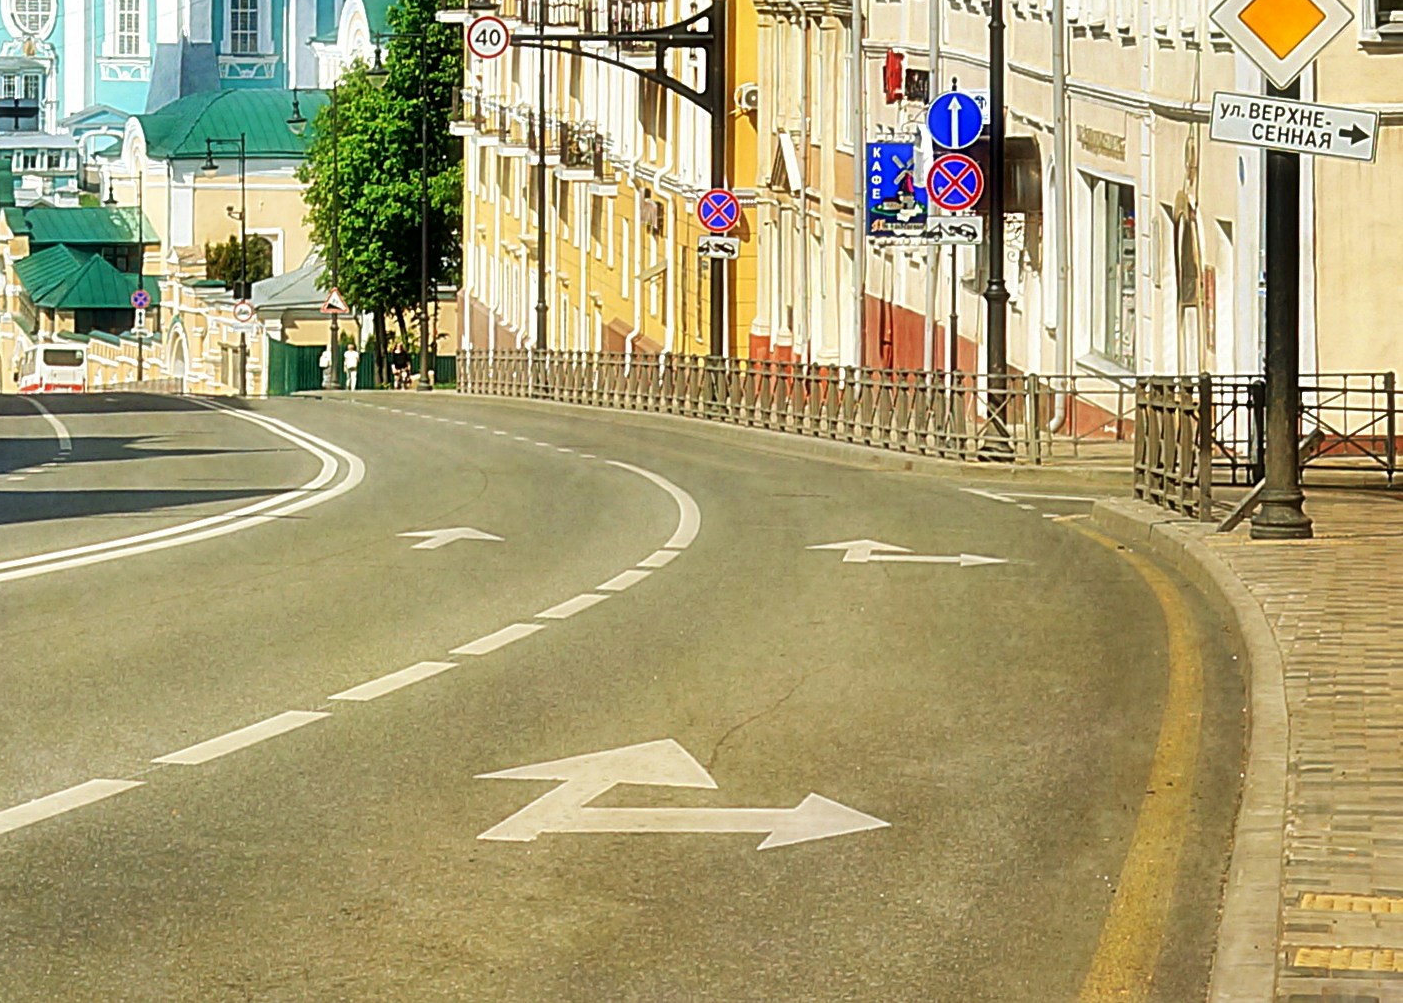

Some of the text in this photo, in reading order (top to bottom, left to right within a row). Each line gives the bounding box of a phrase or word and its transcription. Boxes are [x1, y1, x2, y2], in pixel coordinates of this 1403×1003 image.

[474, 28, 502, 47] 40
[1219, 102, 1331, 128] ул. ВЕРХНЕ-
[1252, 123, 1332, 149] СЕННАЯ
[871, 147, 883, 200] КАФЕ
